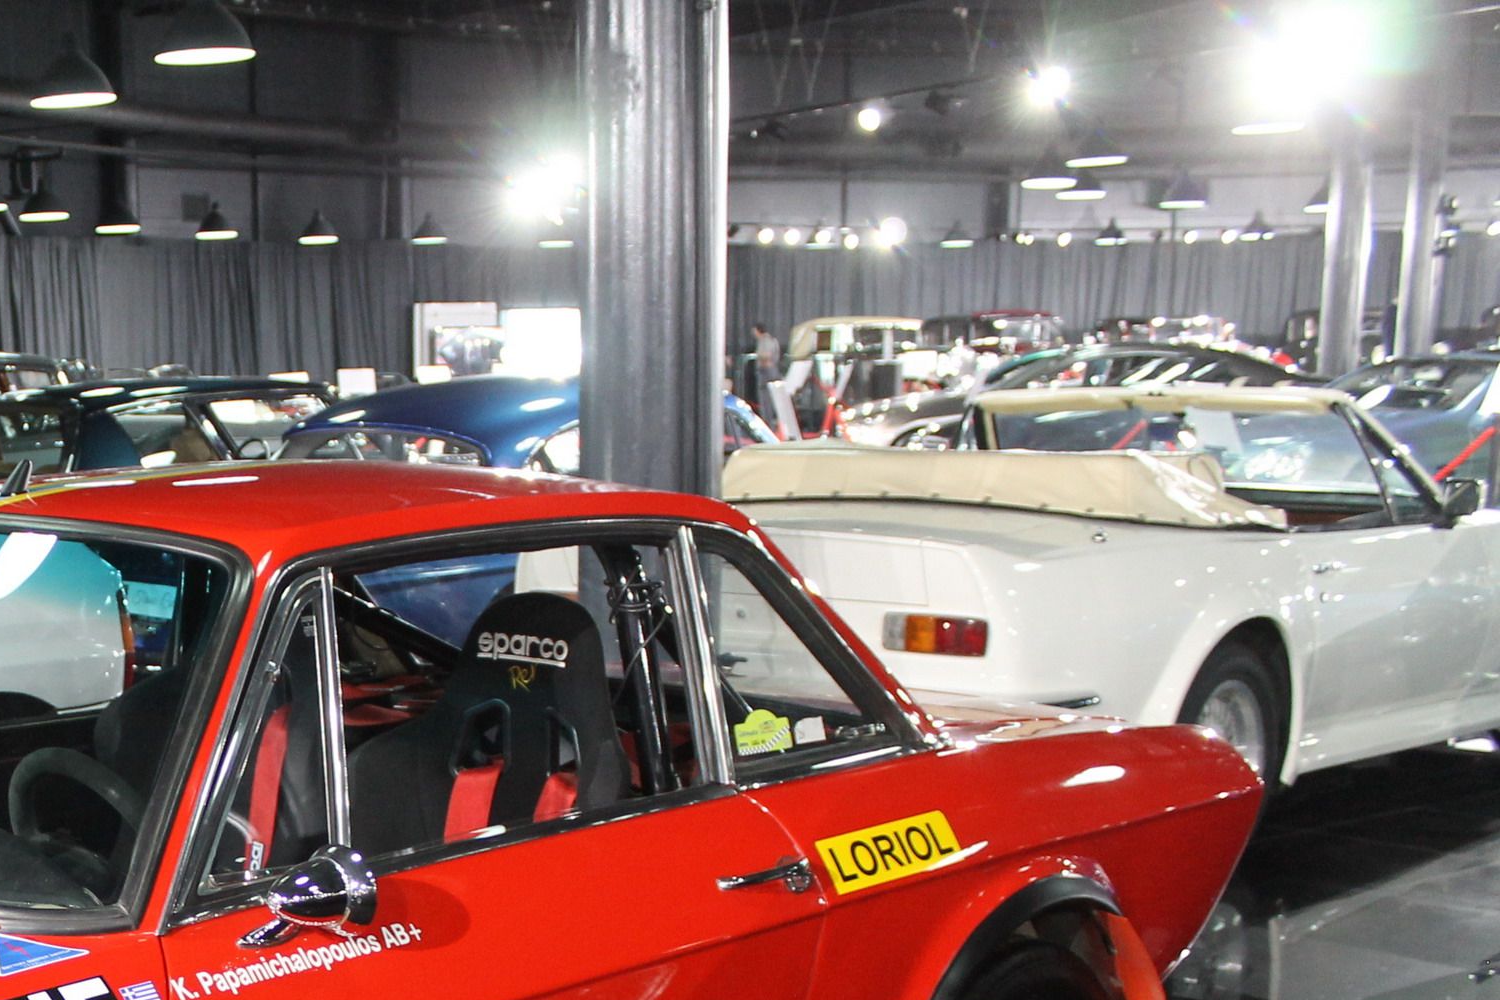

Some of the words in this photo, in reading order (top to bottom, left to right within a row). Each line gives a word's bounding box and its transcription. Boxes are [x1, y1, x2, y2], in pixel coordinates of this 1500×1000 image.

[478, 631, 568, 660] sparco
[828, 822, 954, 882] LORIOL
[170, 976, 200, 1000] K.
[196, 934, 382, 995] Papamichalopoulos
[381, 922, 422, 949] AB+
